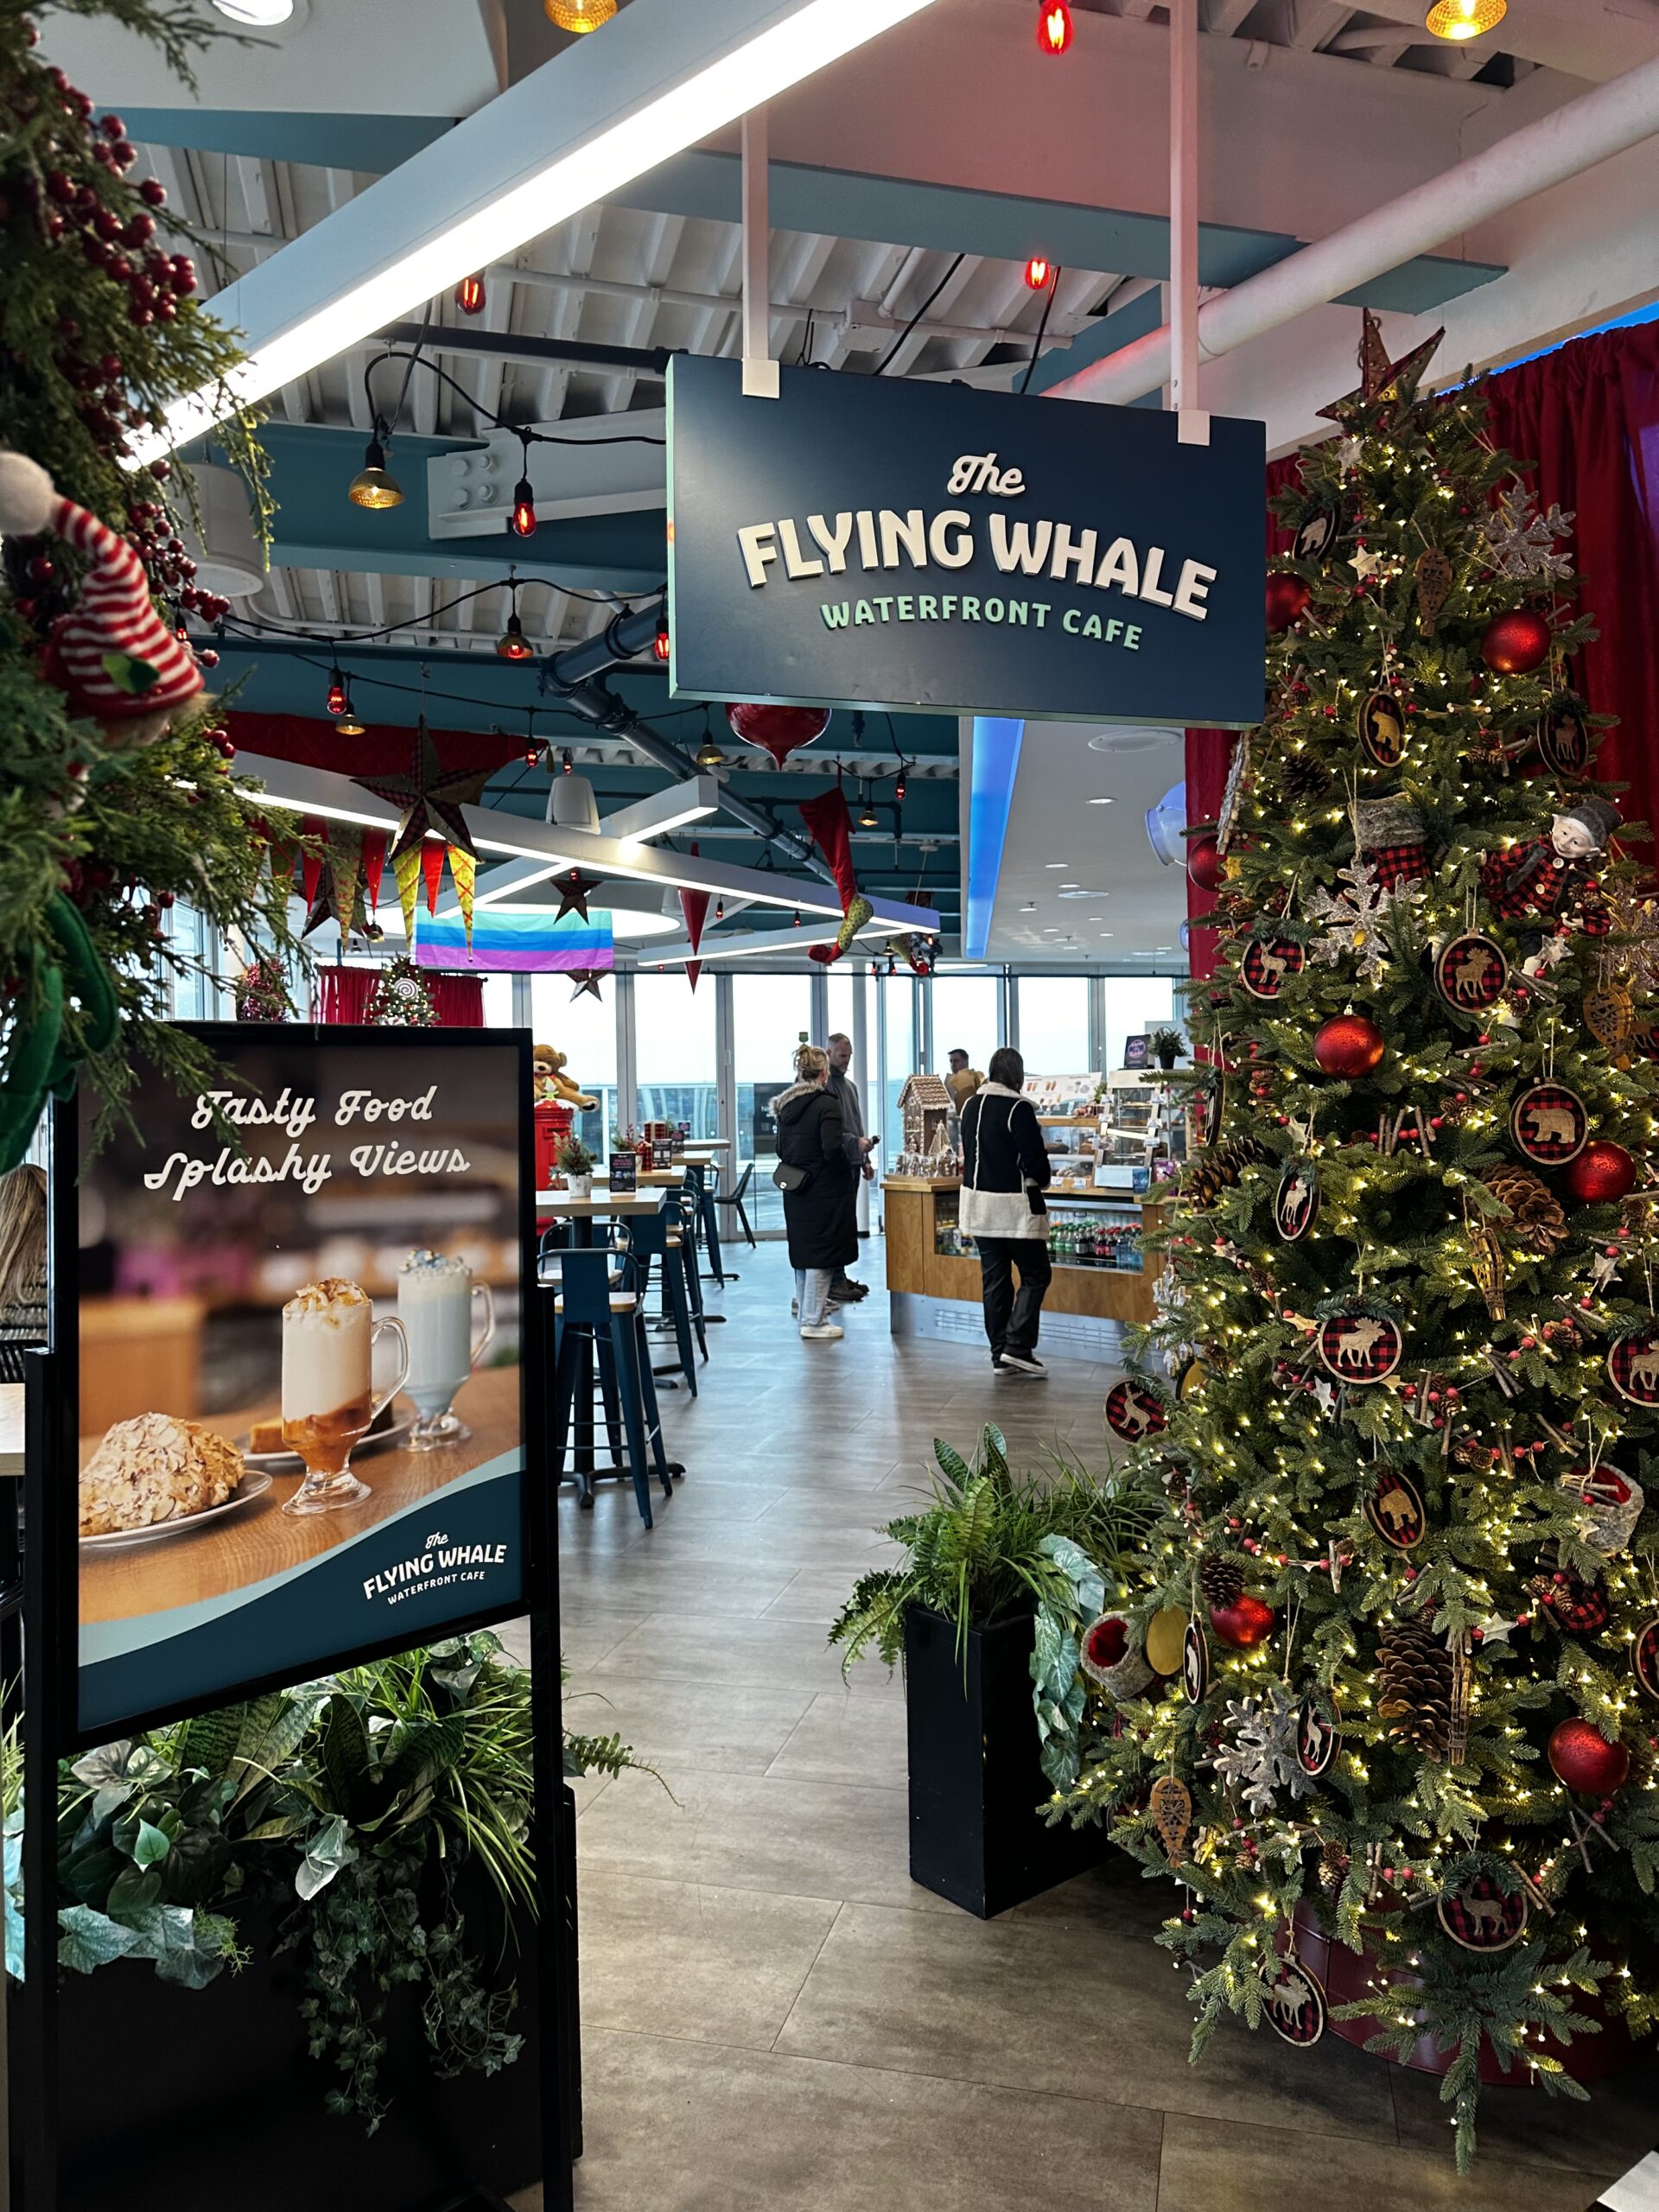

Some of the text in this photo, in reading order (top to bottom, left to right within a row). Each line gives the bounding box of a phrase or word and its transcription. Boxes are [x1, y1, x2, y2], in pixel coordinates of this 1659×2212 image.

[947, 453, 1026, 497] The
[737, 509, 1217, 621] FLYING WHALE
[820, 594, 1143, 651] WATERFRONT CAFE
[191, 1085, 438, 1137] Tasty Food
[143, 1141, 471, 1202] Splashy Views
[425, 1532, 448, 1549] The
[363, 1544, 507, 1600] FLYING WHALE
[387, 1571, 485, 1605] WATERFRONT CAFE
